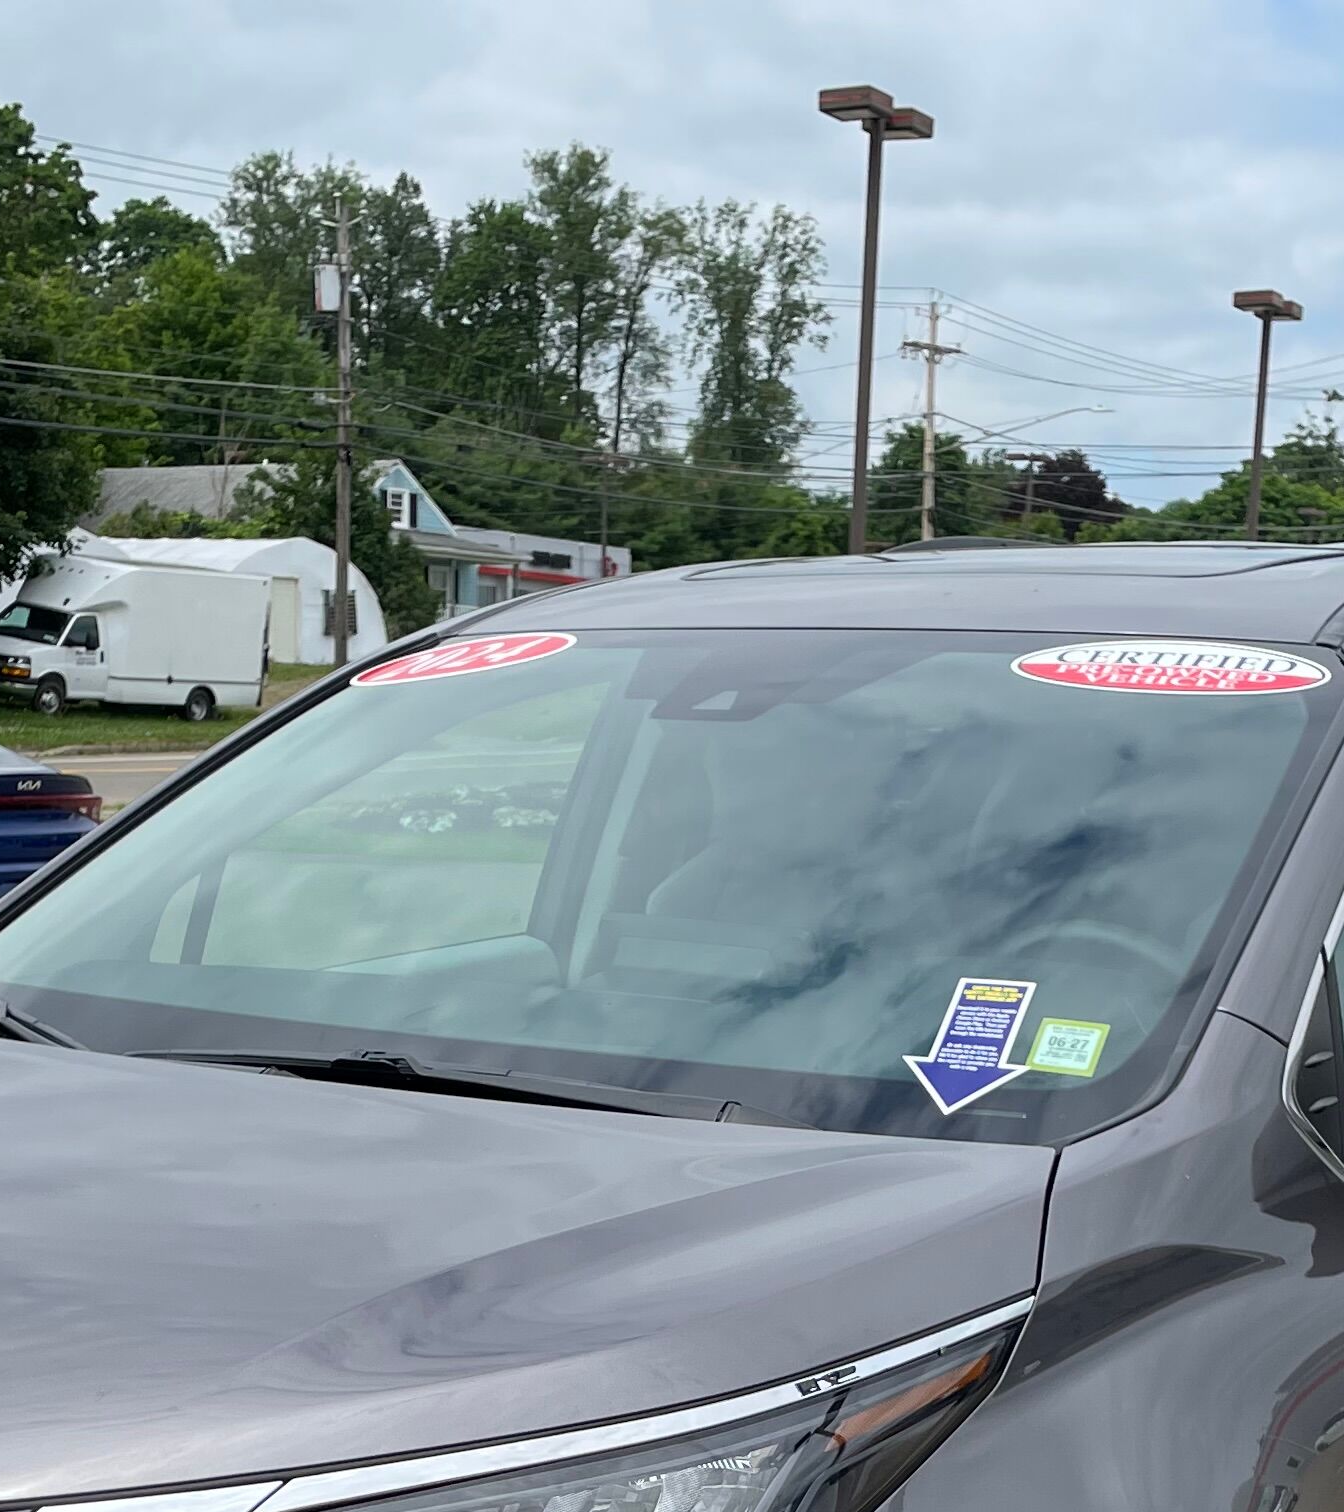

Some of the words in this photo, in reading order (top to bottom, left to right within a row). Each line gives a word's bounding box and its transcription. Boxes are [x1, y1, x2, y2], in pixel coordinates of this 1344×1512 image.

[367, 636, 551, 682] 2024
[1056, 649, 1298, 673] CERTIFIED
[1056, 664, 1277, 684] PRE-OWNED
[1086, 672, 1237, 690] VEHICLE
